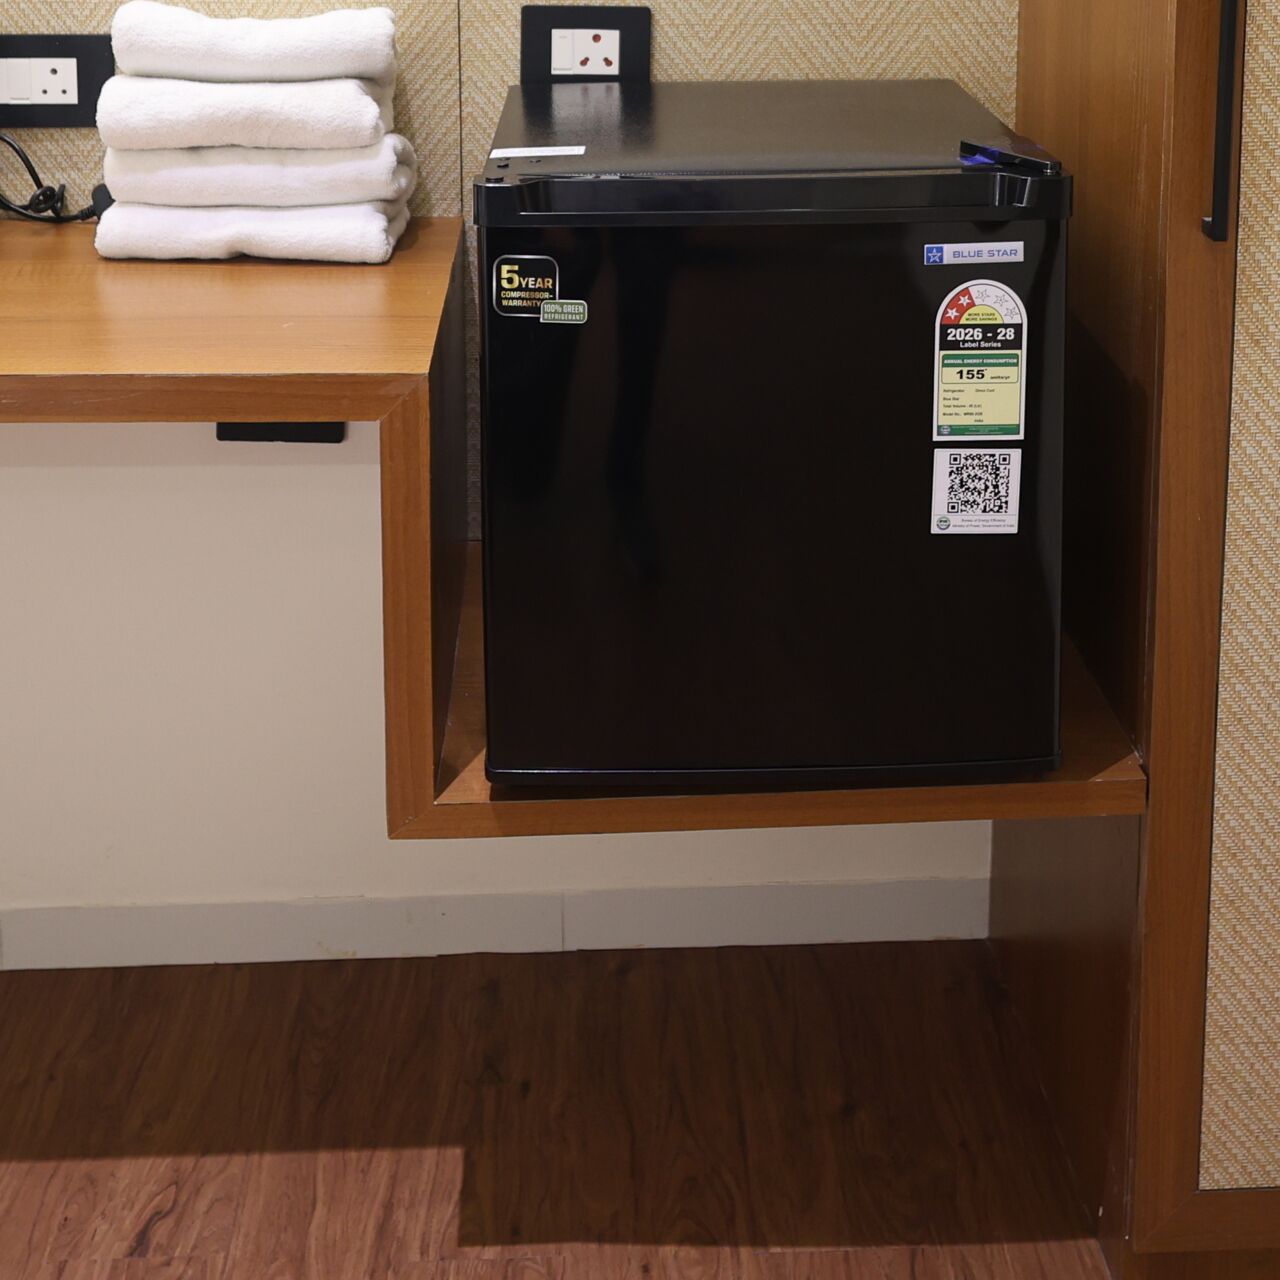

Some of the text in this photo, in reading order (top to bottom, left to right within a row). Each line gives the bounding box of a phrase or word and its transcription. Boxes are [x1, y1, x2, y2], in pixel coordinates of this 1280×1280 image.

[952, 249, 1018, 259] BLUE STAR
[501, 264, 553, 289] 5 YEAR
[501, 299, 541, 307] WARRANTY
[544, 304, 584, 313] 100% GREEN
[947, 328, 983, 340] 2026
[997, 327, 1015, 340] 28
